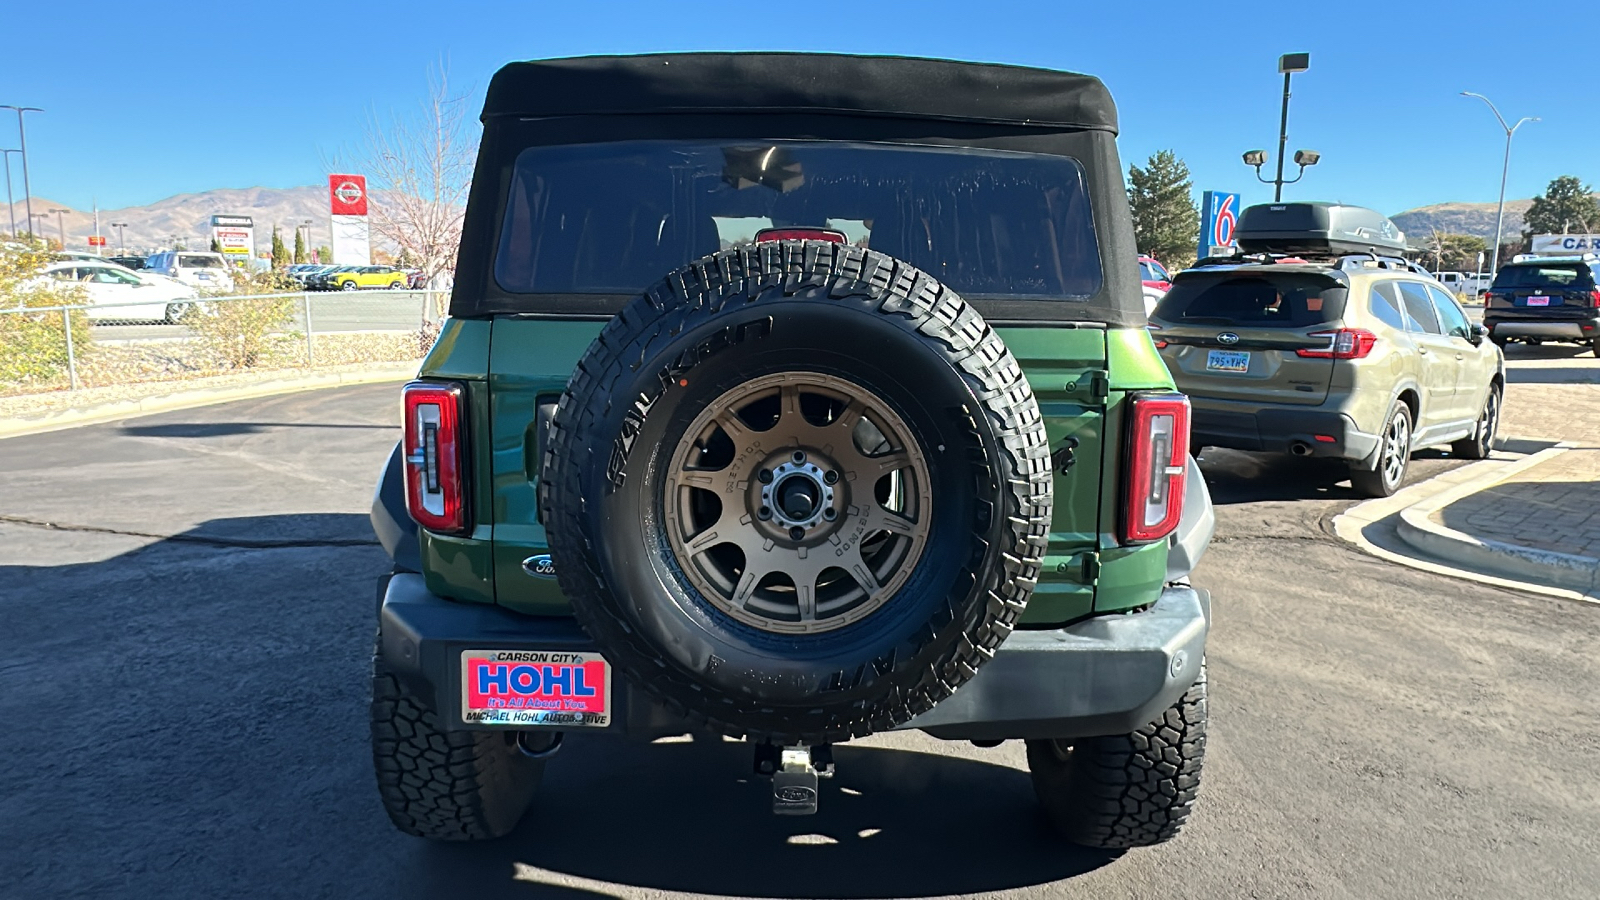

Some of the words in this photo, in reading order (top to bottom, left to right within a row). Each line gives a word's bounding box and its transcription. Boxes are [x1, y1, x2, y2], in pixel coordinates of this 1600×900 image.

[1215, 195, 1236, 247] 6
[497, 652, 549, 663] CARSON
[551, 653, 579, 664] CITY
[477, 664, 597, 697] HOHL
[487, 697, 505, 708] It's
[507, 698, 524, 708] All
[525, 698, 561, 708] About
[466, 712, 511, 722] MICHAEL
[512, 712, 540, 722] HOHL
